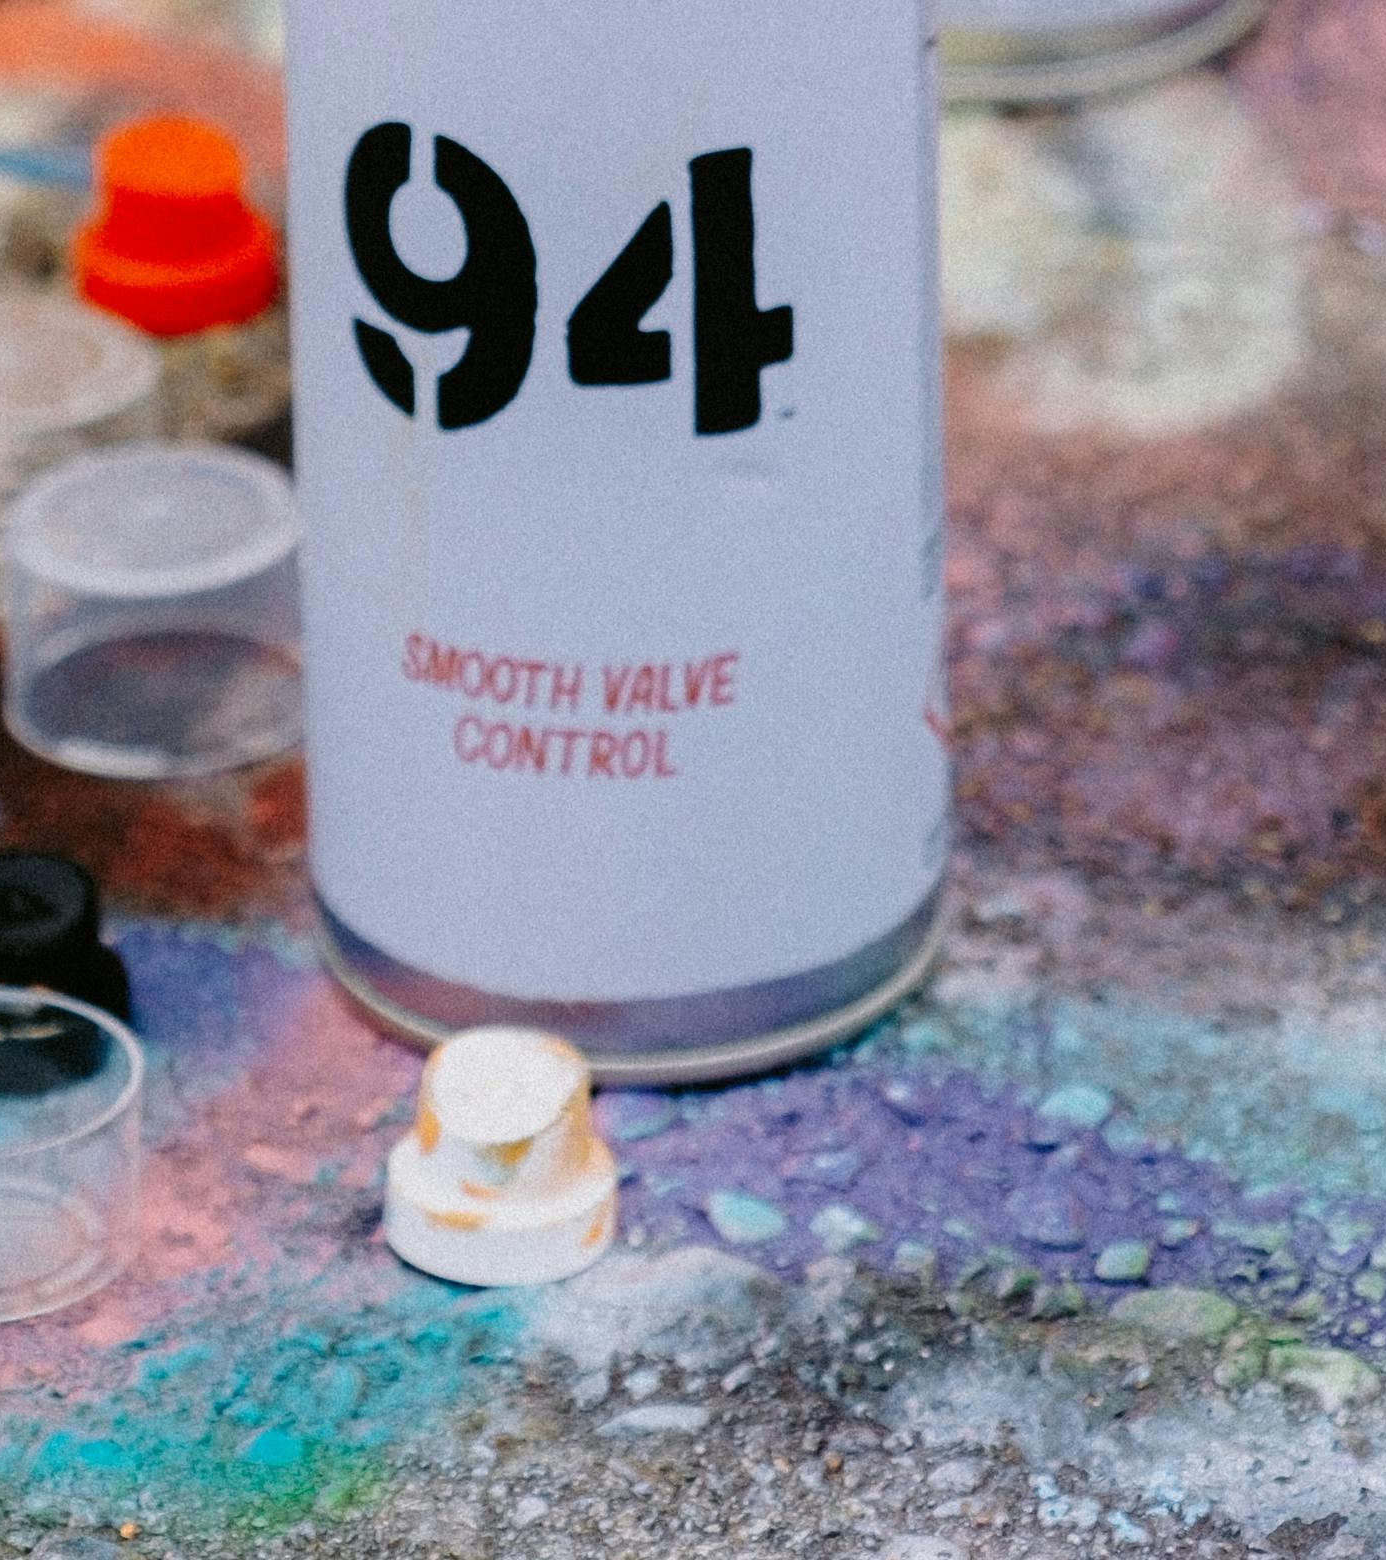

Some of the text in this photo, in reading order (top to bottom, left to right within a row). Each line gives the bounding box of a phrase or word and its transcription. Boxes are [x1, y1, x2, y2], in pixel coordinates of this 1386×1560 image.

[345, 122, 793, 436] 94
[402, 632, 740, 714] SMOOTH VALVE
[453, 714, 677, 780] CONTROL
